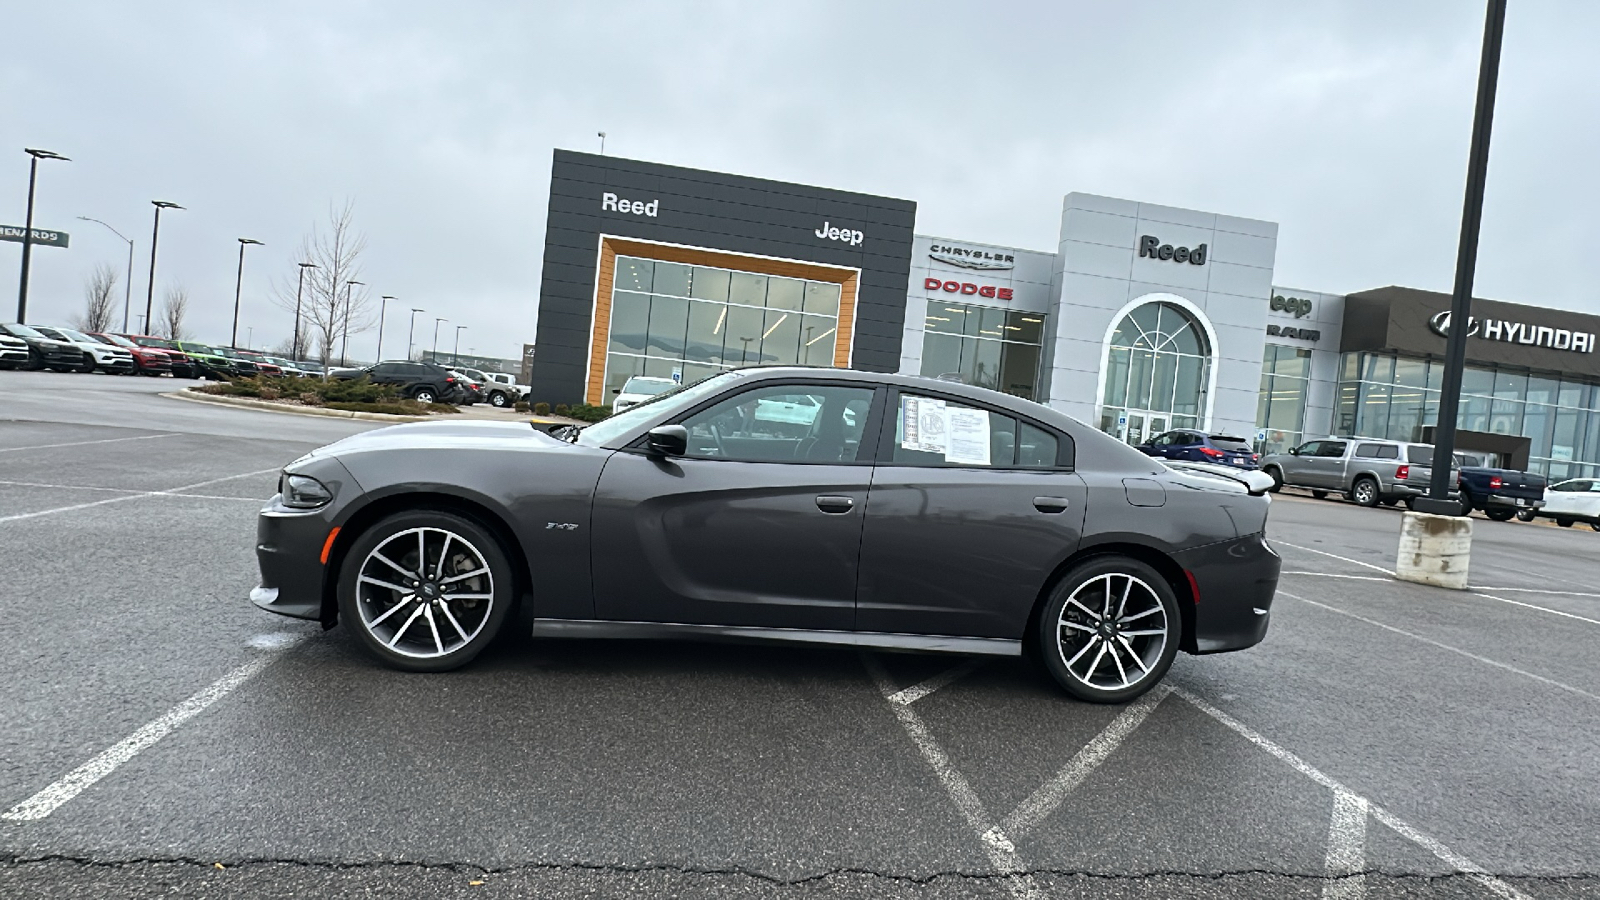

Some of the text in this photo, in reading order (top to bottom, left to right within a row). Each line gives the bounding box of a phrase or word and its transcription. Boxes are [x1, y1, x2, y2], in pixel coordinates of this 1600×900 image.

[602, 192, 659, 217] Reed
[815, 221, 864, 246] Jeep
[930, 244, 1015, 262] CHRYSLER
[1139, 234, 1208, 265] Reed
[924, 278, 1014, 300] DODGE
[1266, 324, 1321, 342] RAM
[1484, 319, 1596, 353] HYUNDAI
